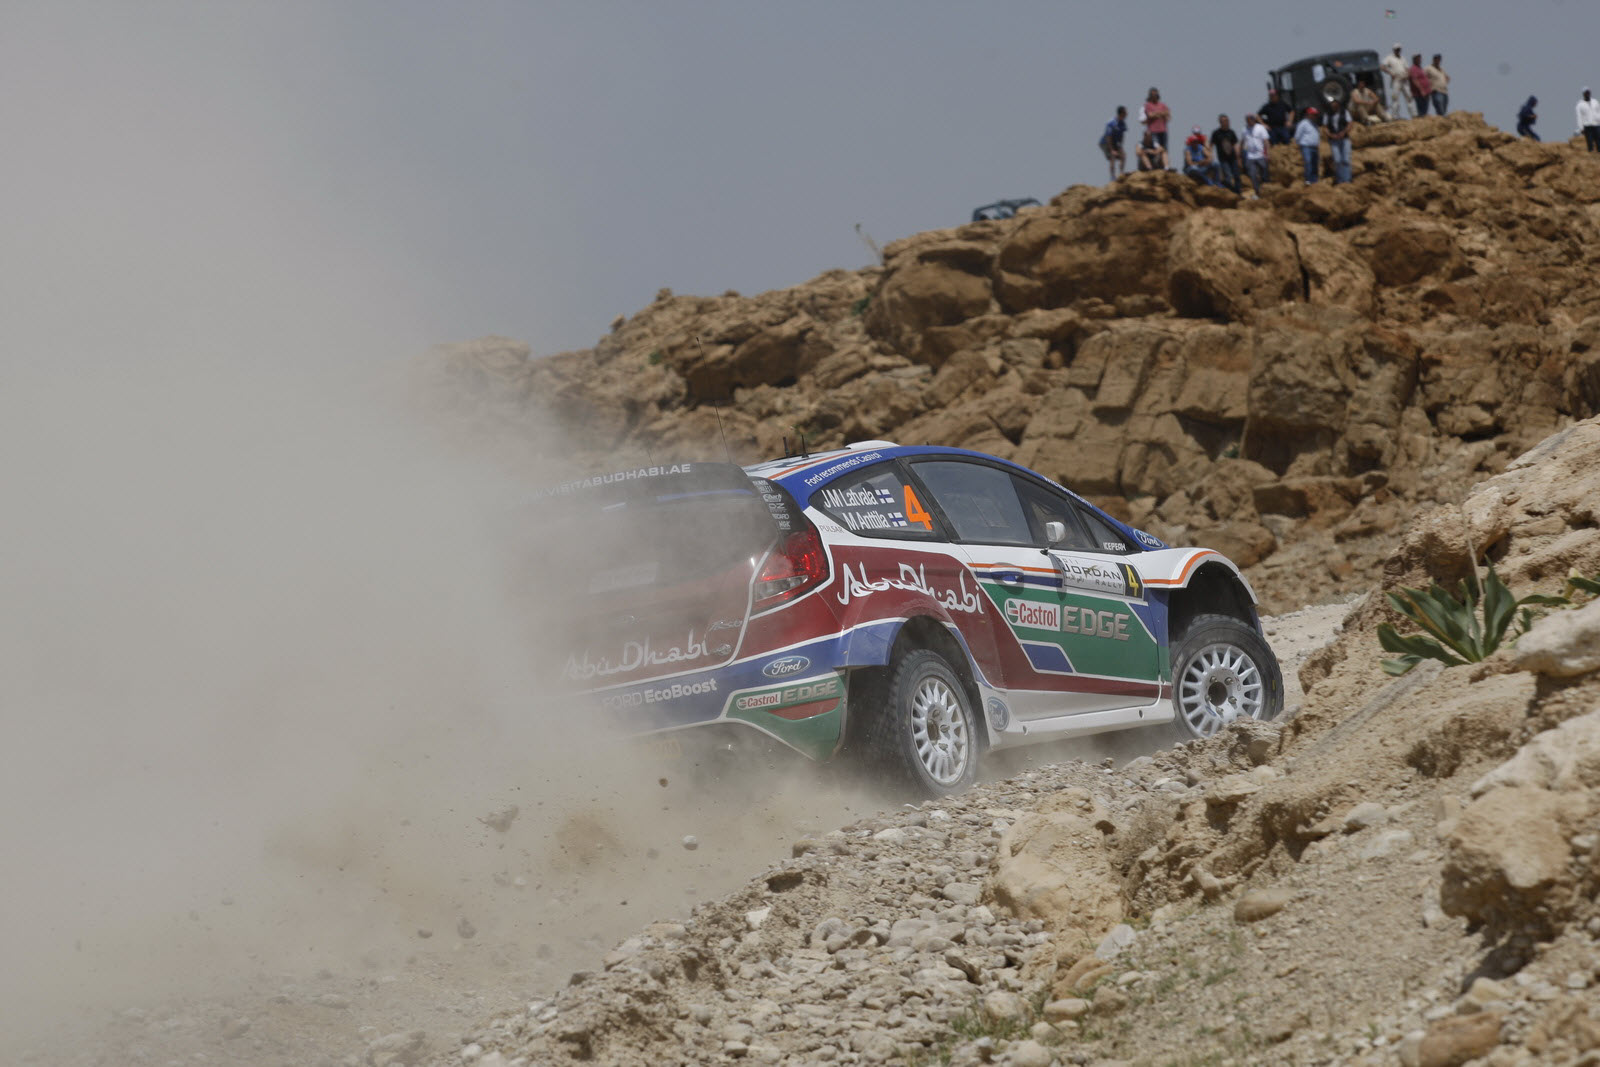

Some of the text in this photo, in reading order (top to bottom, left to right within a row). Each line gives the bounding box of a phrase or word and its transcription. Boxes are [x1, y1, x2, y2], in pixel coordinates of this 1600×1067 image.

[803, 452, 883, 487] Ford recommends Castrol
[838, 488, 879, 507] Latvala
[903, 484, 933, 531] 4
[842, 510, 891, 531] M Anttila
[837, 561, 985, 614] Abu Dhabi
[1062, 563, 1122, 581] JORDAN
[1095, 579, 1123, 590] RALLY
[1125, 564, 1139, 597] 4
[1019, 602, 1131, 641] Castrol EDGE
[560, 628, 710, 681] Abu Dhabi
[771, 658, 802, 675] Ford
[603, 678, 718, 710] FORD EcoBoost
[747, 680, 838, 708] Castrol EDGE
